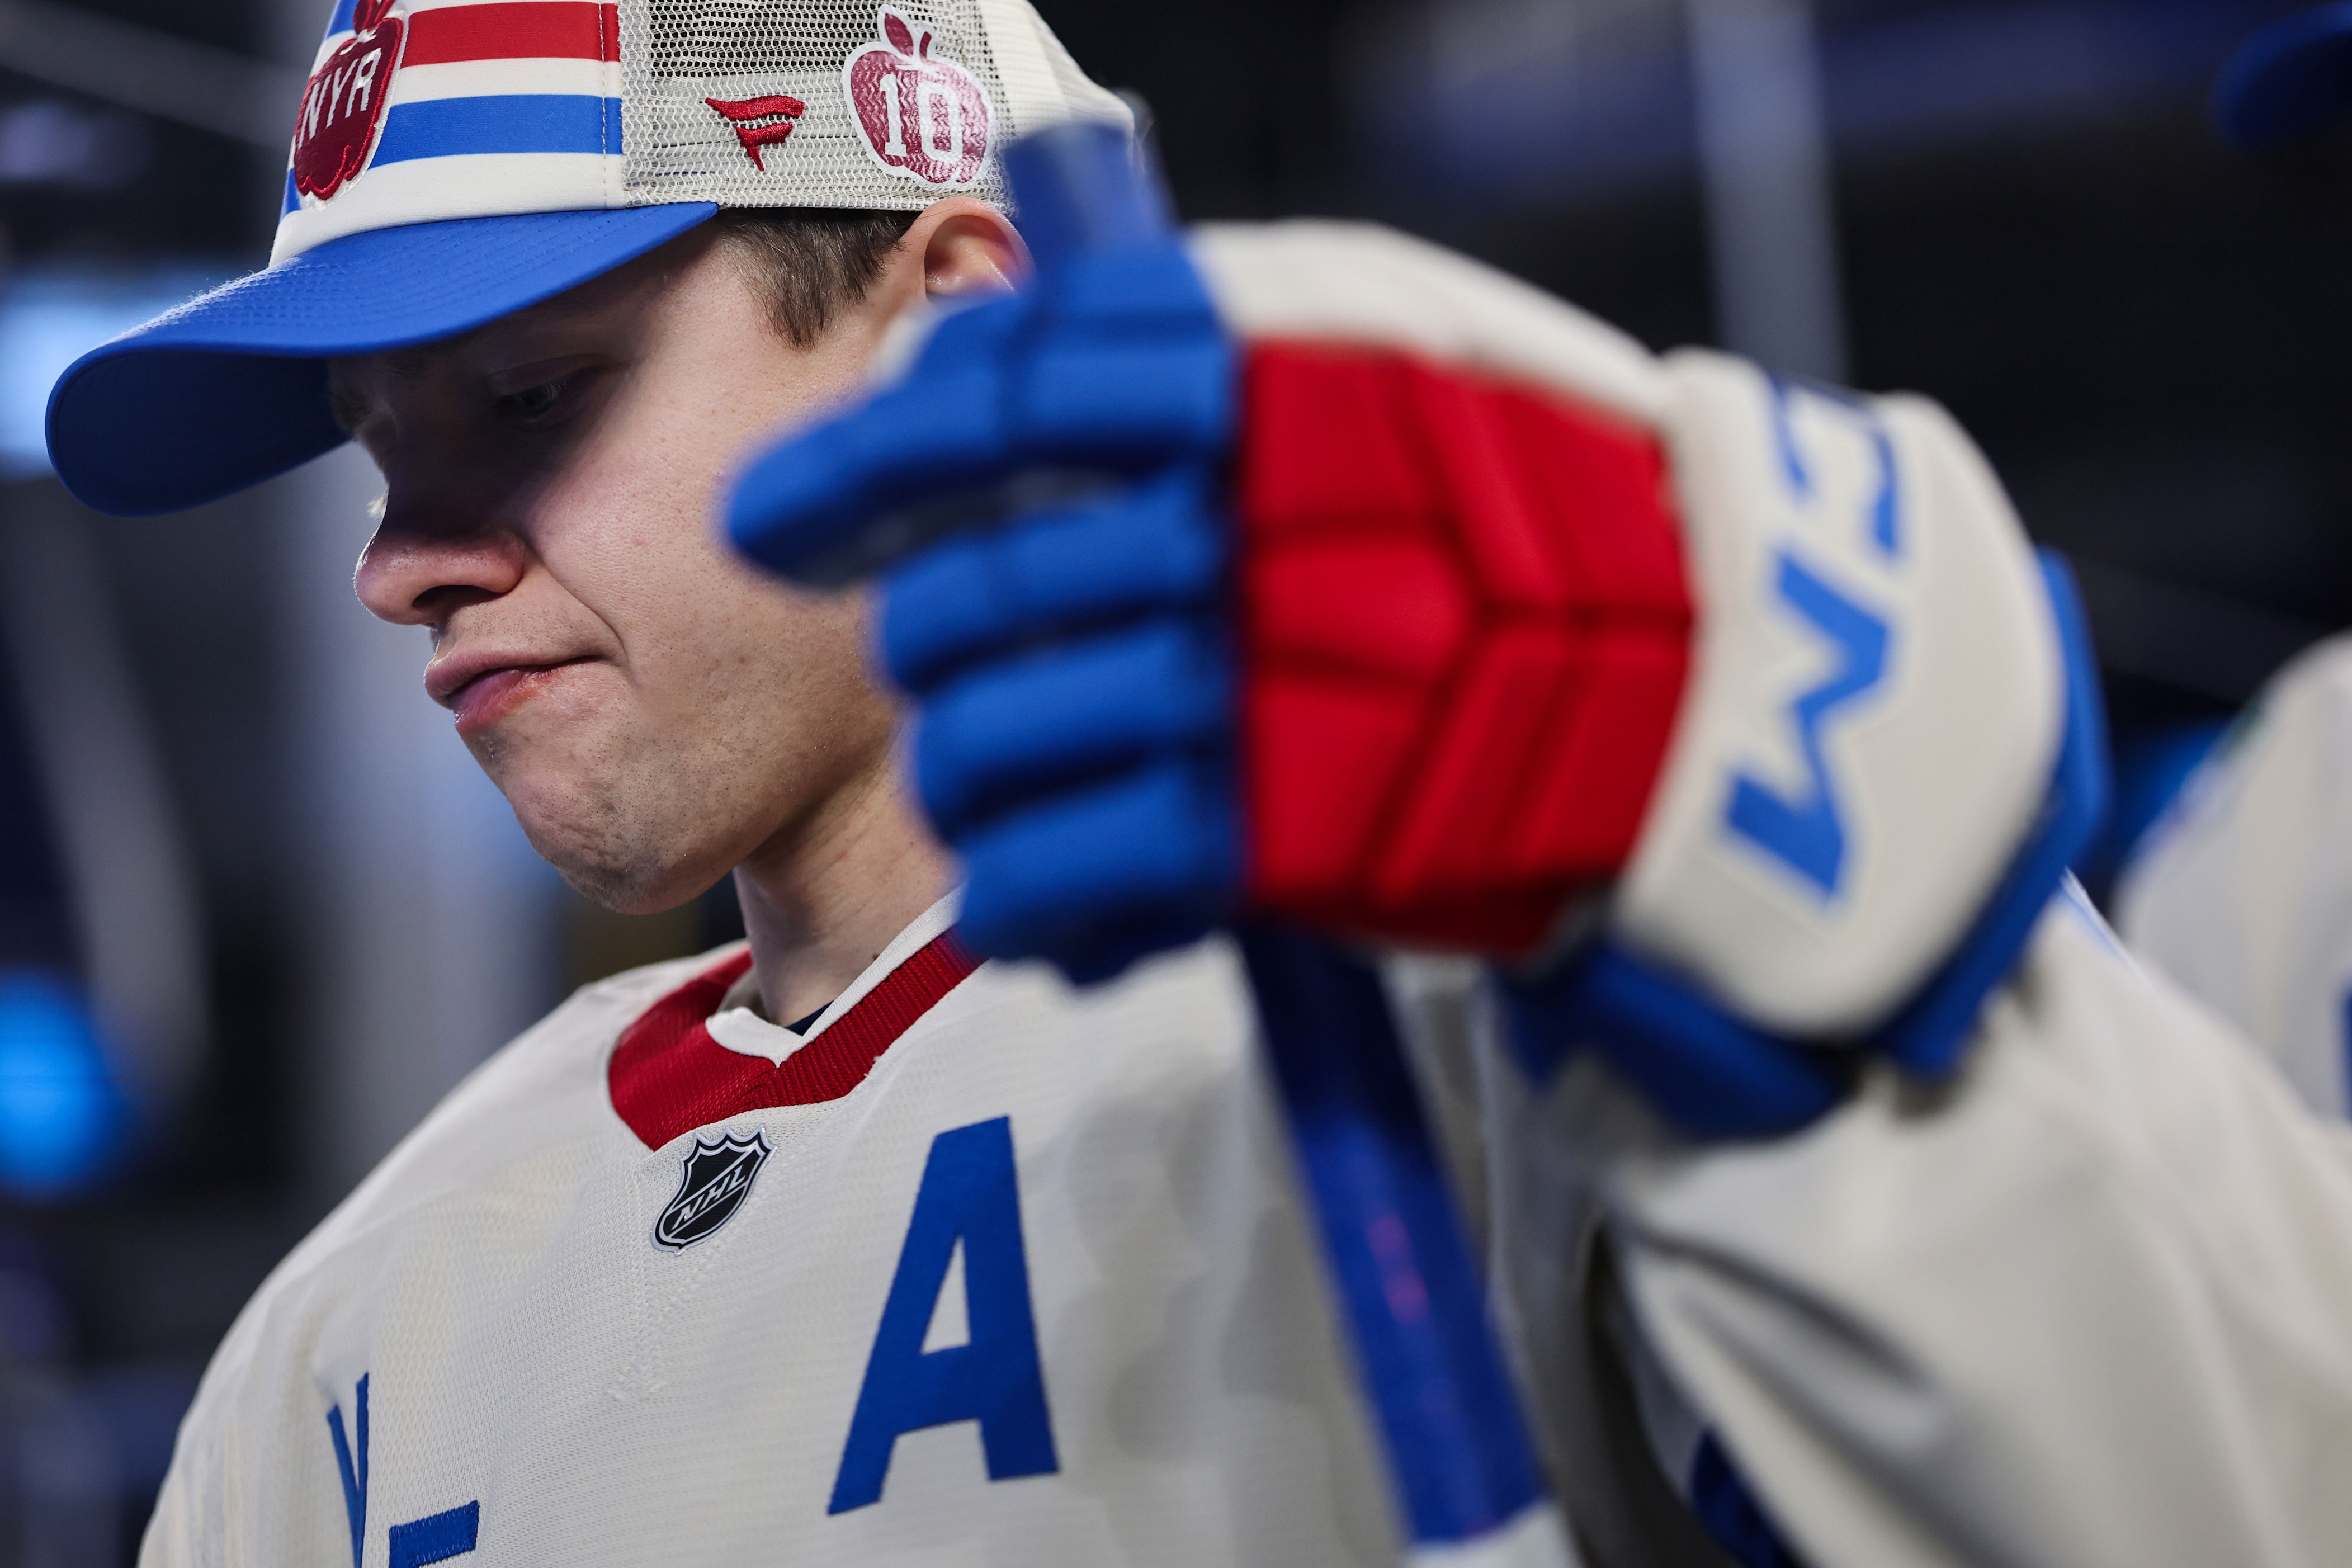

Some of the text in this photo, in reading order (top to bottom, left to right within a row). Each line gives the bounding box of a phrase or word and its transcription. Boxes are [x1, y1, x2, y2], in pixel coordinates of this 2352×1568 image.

[297, 47, 381, 151] NYR
[880, 73, 964, 164] 10
[671, 1165, 746, 1230] NHL
[827, 1114, 1060, 1516] A
